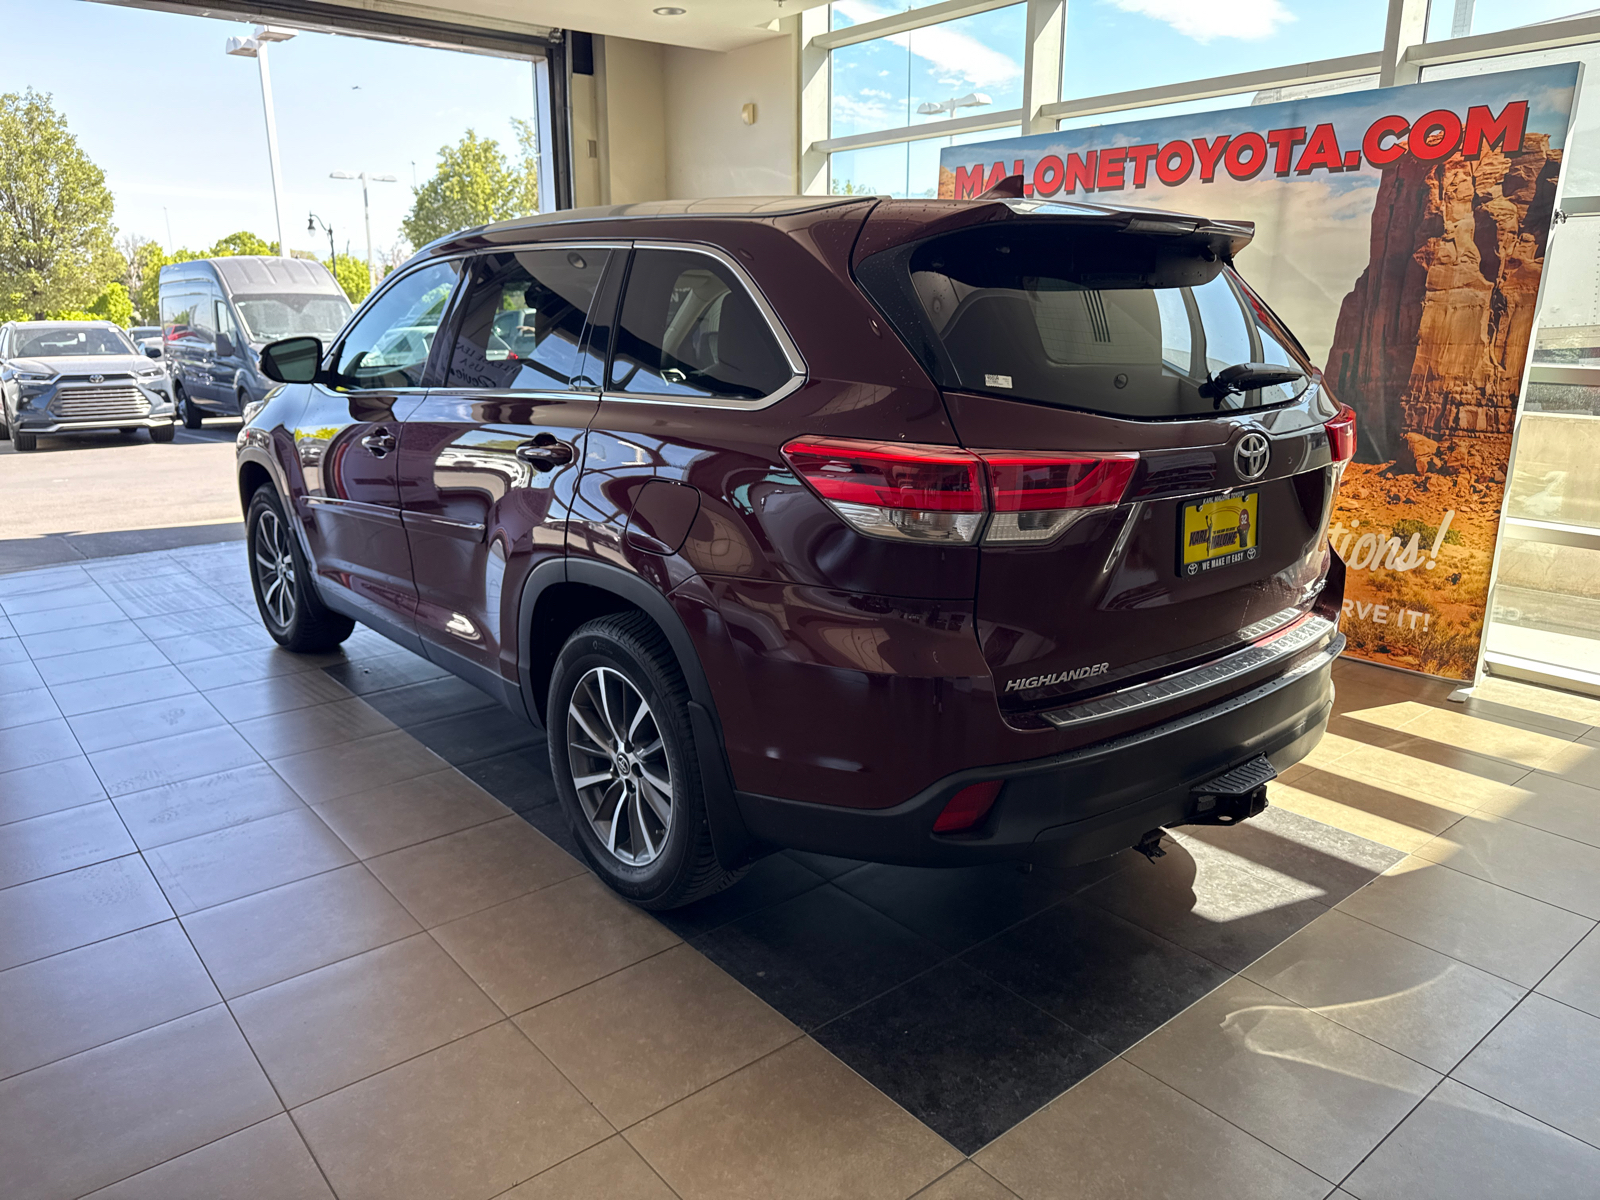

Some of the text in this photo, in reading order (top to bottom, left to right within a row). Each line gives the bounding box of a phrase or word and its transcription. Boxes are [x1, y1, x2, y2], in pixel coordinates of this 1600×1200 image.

[954, 100, 1529, 200] MALONETOYOTA.COM
[1241, 513, 1248, 525] 32
[1189, 529, 1209, 547] KARL
[1327, 509, 1455, 572] tions!
[1202, 552, 1244, 571] WE MAKE IT EASY
[1341, 598, 1431, 632] RVE IT!
[1004, 662, 1110, 692] HIGHLANDER
